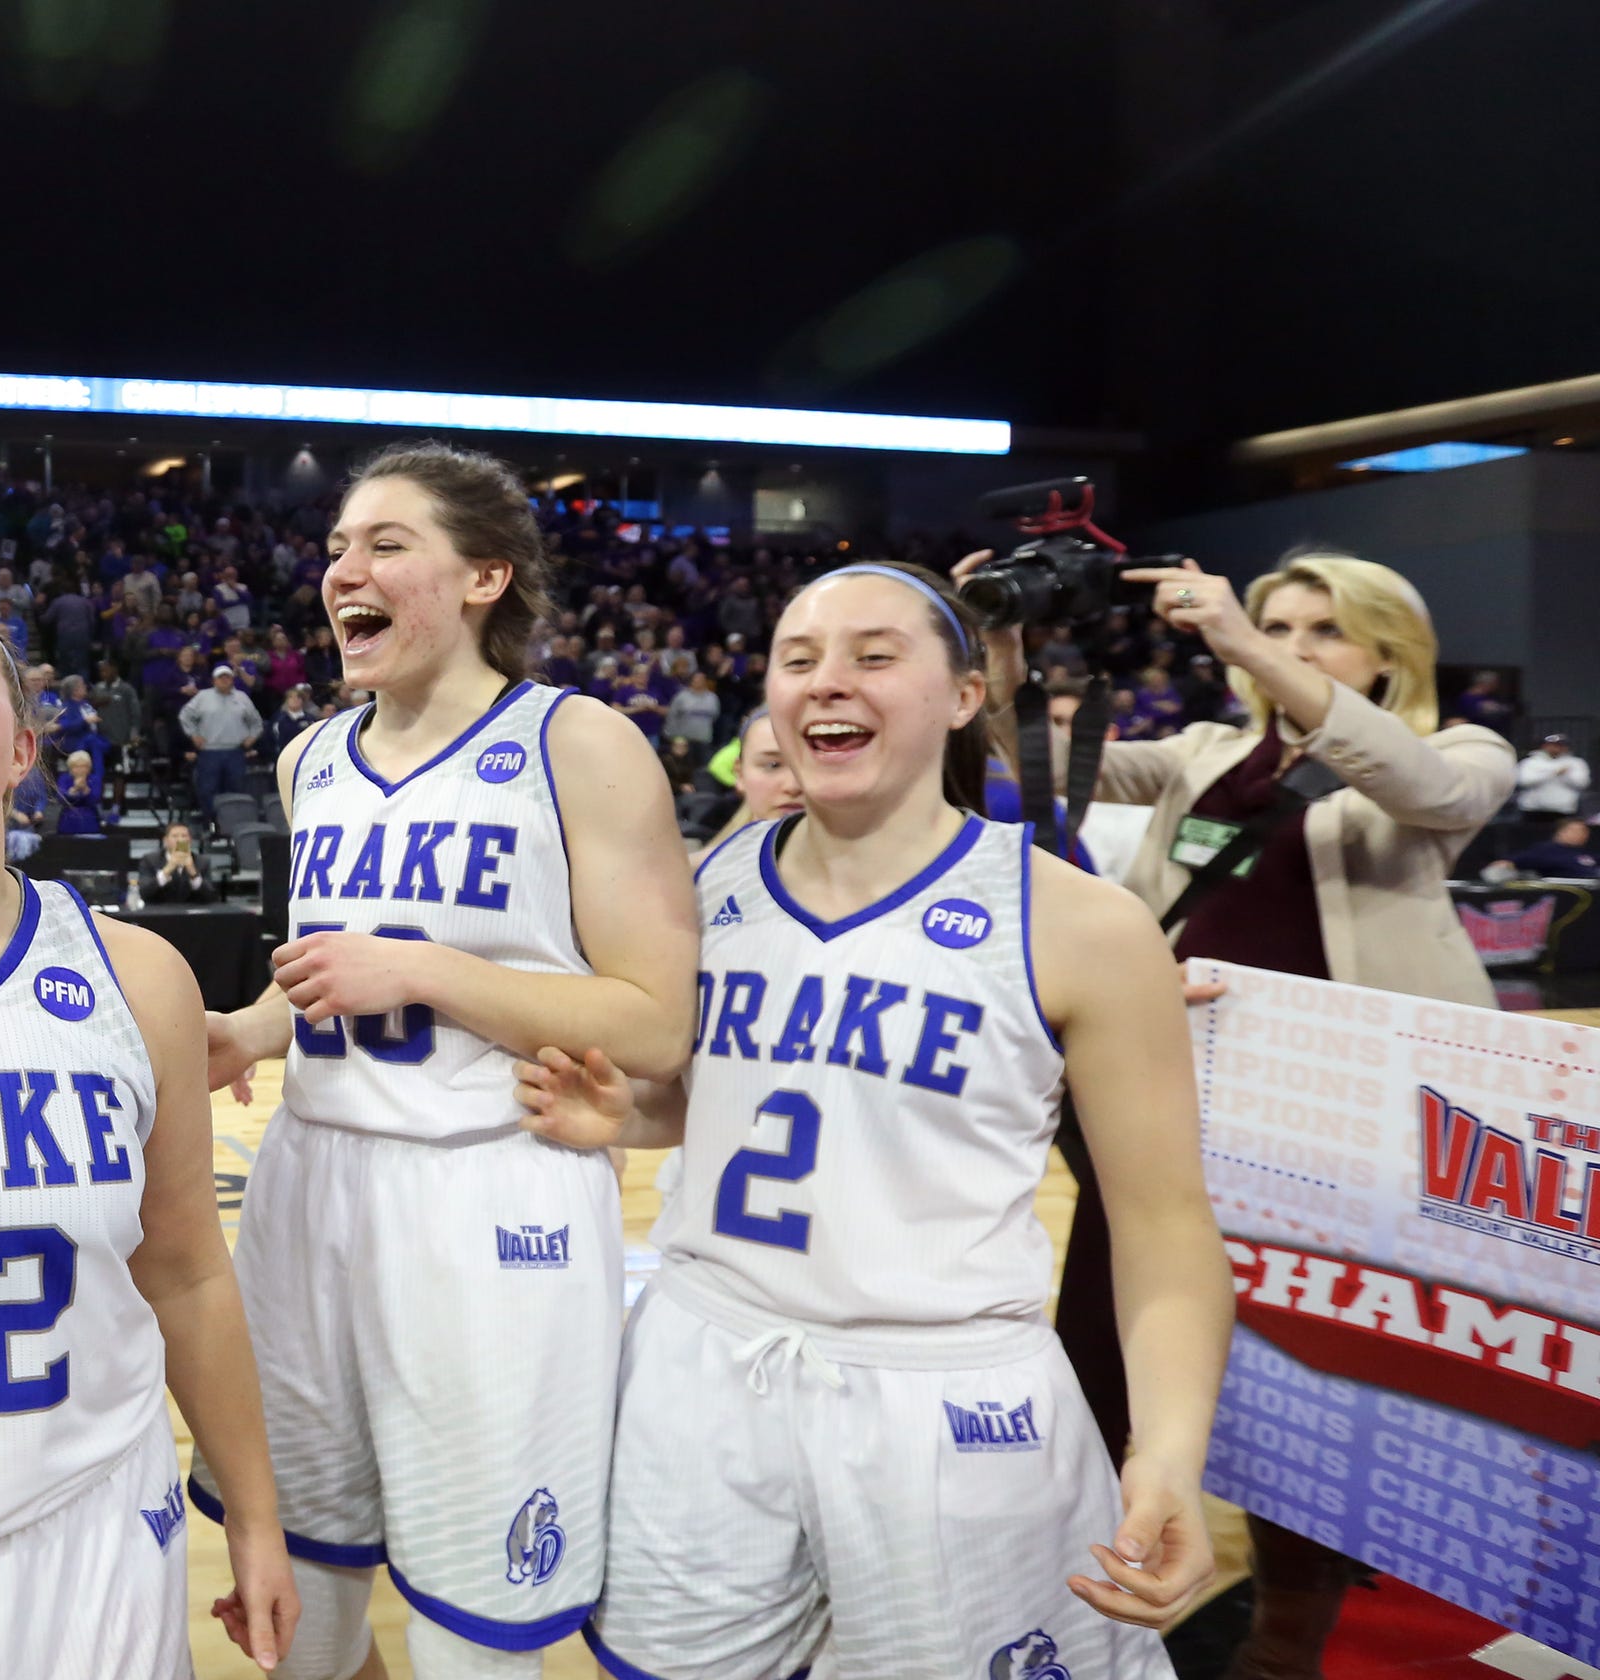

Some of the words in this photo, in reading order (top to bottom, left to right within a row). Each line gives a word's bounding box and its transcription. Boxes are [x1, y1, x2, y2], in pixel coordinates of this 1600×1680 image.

[480, 752, 523, 771] PFM
[926, 906, 988, 940] PFM
[39, 977, 90, 1008] PFM
[712, 1087, 824, 1256] 2
[495, 1223, 569, 1262] VALLEY
[1520, 1230, 1592, 1260] VALLEY
[943, 1396, 1040, 1444] VALLEY
